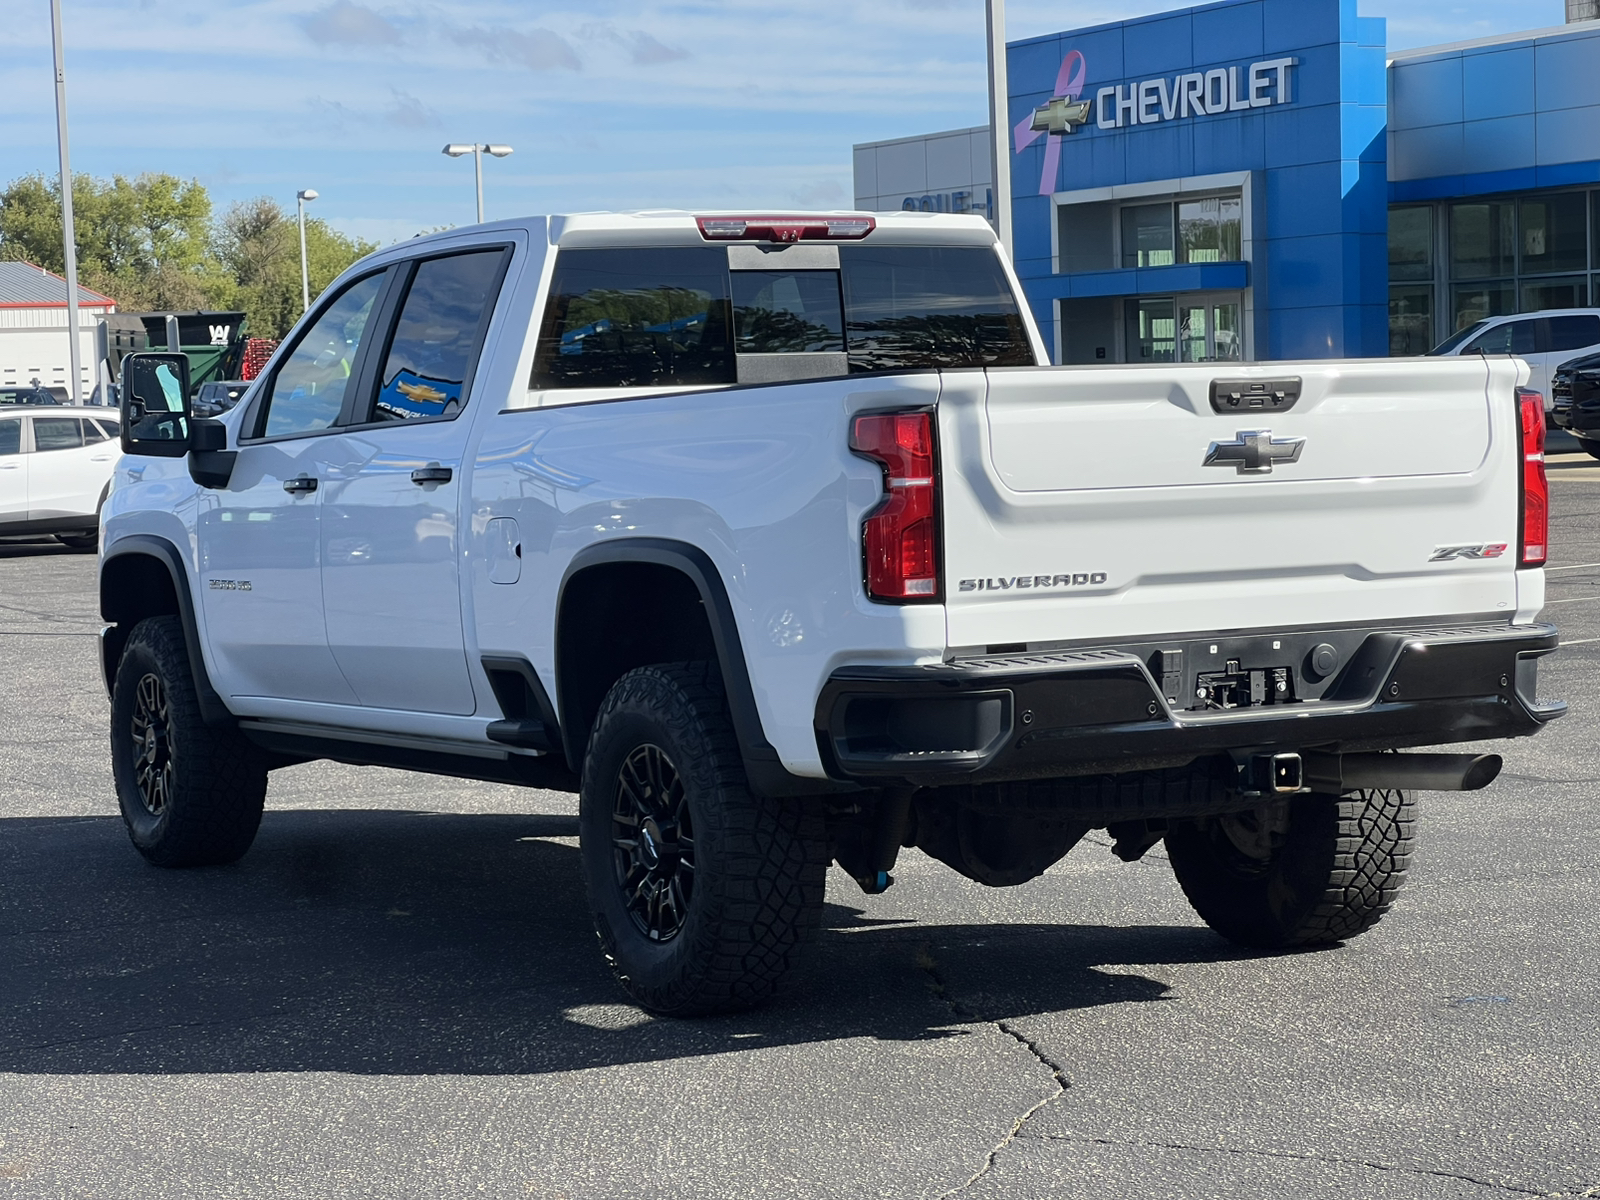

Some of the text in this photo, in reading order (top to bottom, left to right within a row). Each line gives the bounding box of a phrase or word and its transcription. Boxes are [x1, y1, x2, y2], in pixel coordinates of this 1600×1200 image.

[1097, 57, 1297, 129] CHEVROLET
[1427, 543, 1508, 562] ZR2
[958, 572, 1107, 592] SILVERADO
